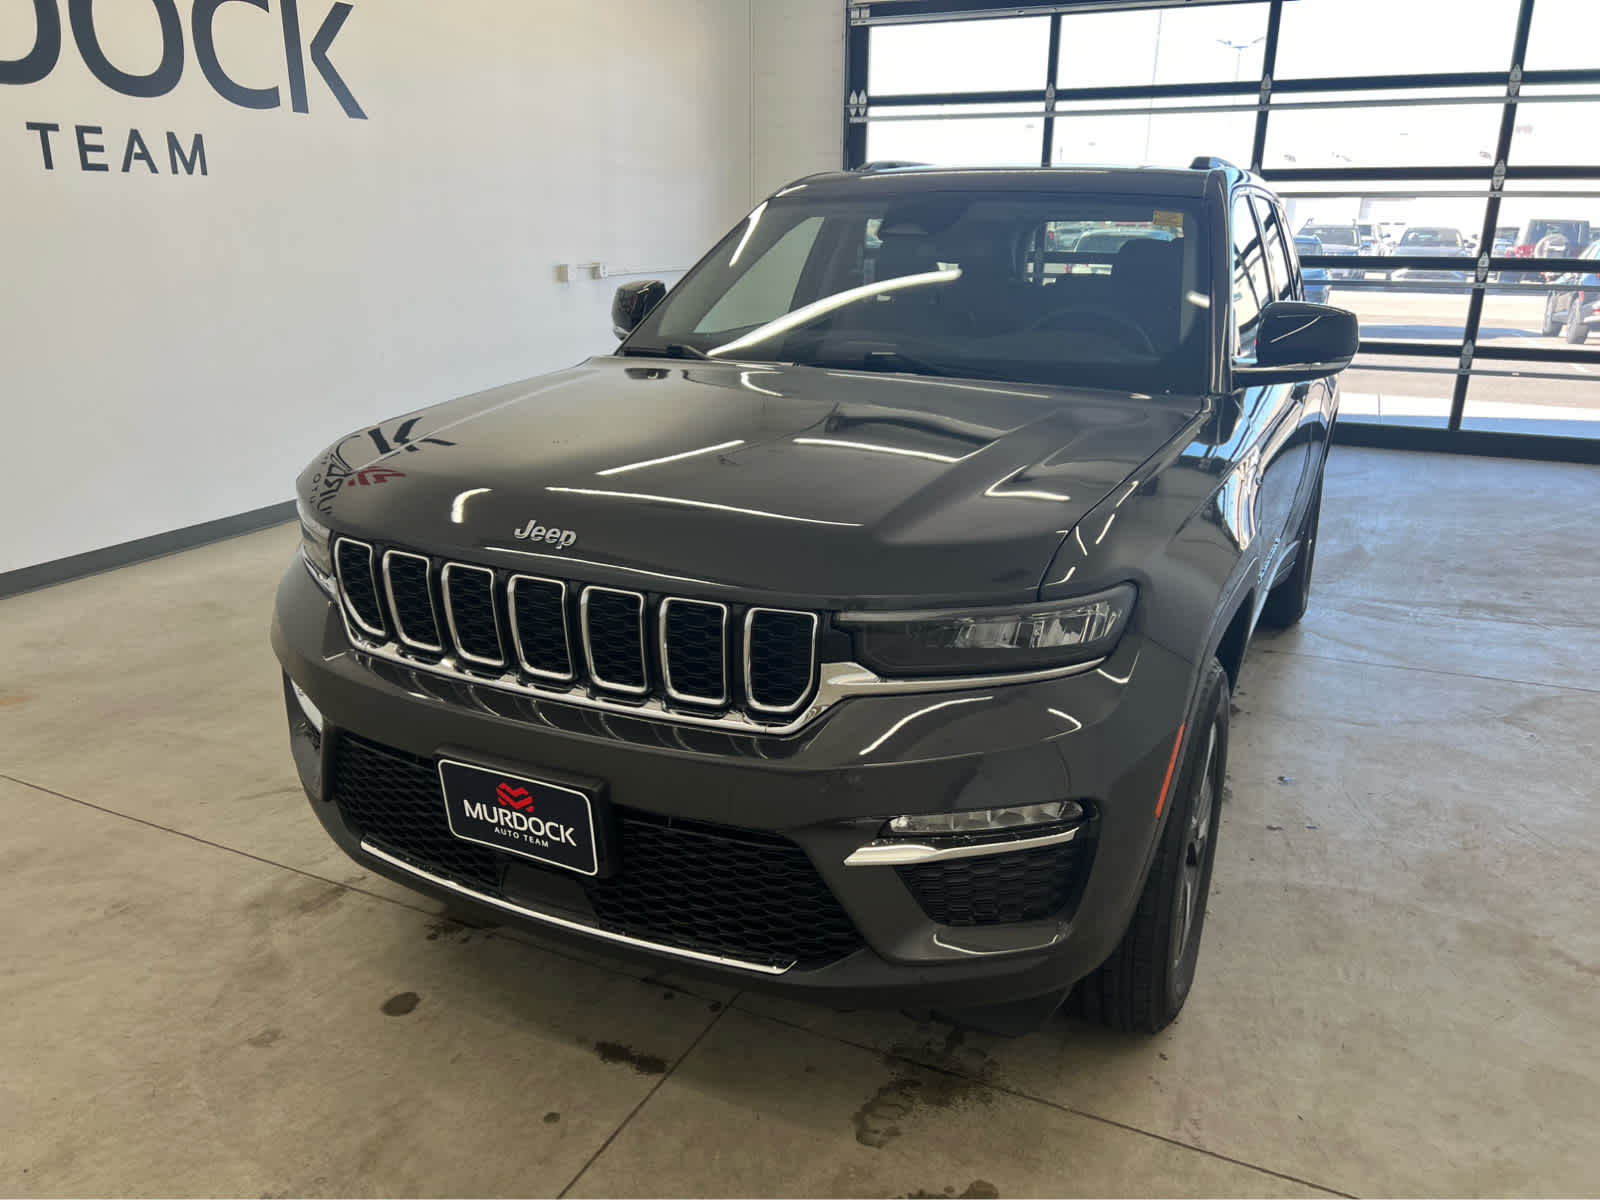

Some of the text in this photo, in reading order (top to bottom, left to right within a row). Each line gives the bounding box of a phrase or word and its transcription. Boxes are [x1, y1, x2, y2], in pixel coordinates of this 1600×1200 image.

[26, 122, 208, 176] TEAM
[514, 519, 577, 549] Jeep
[463, 799, 577, 847] MURDOCK
[494, 827, 549, 848] AUTO TEAM
